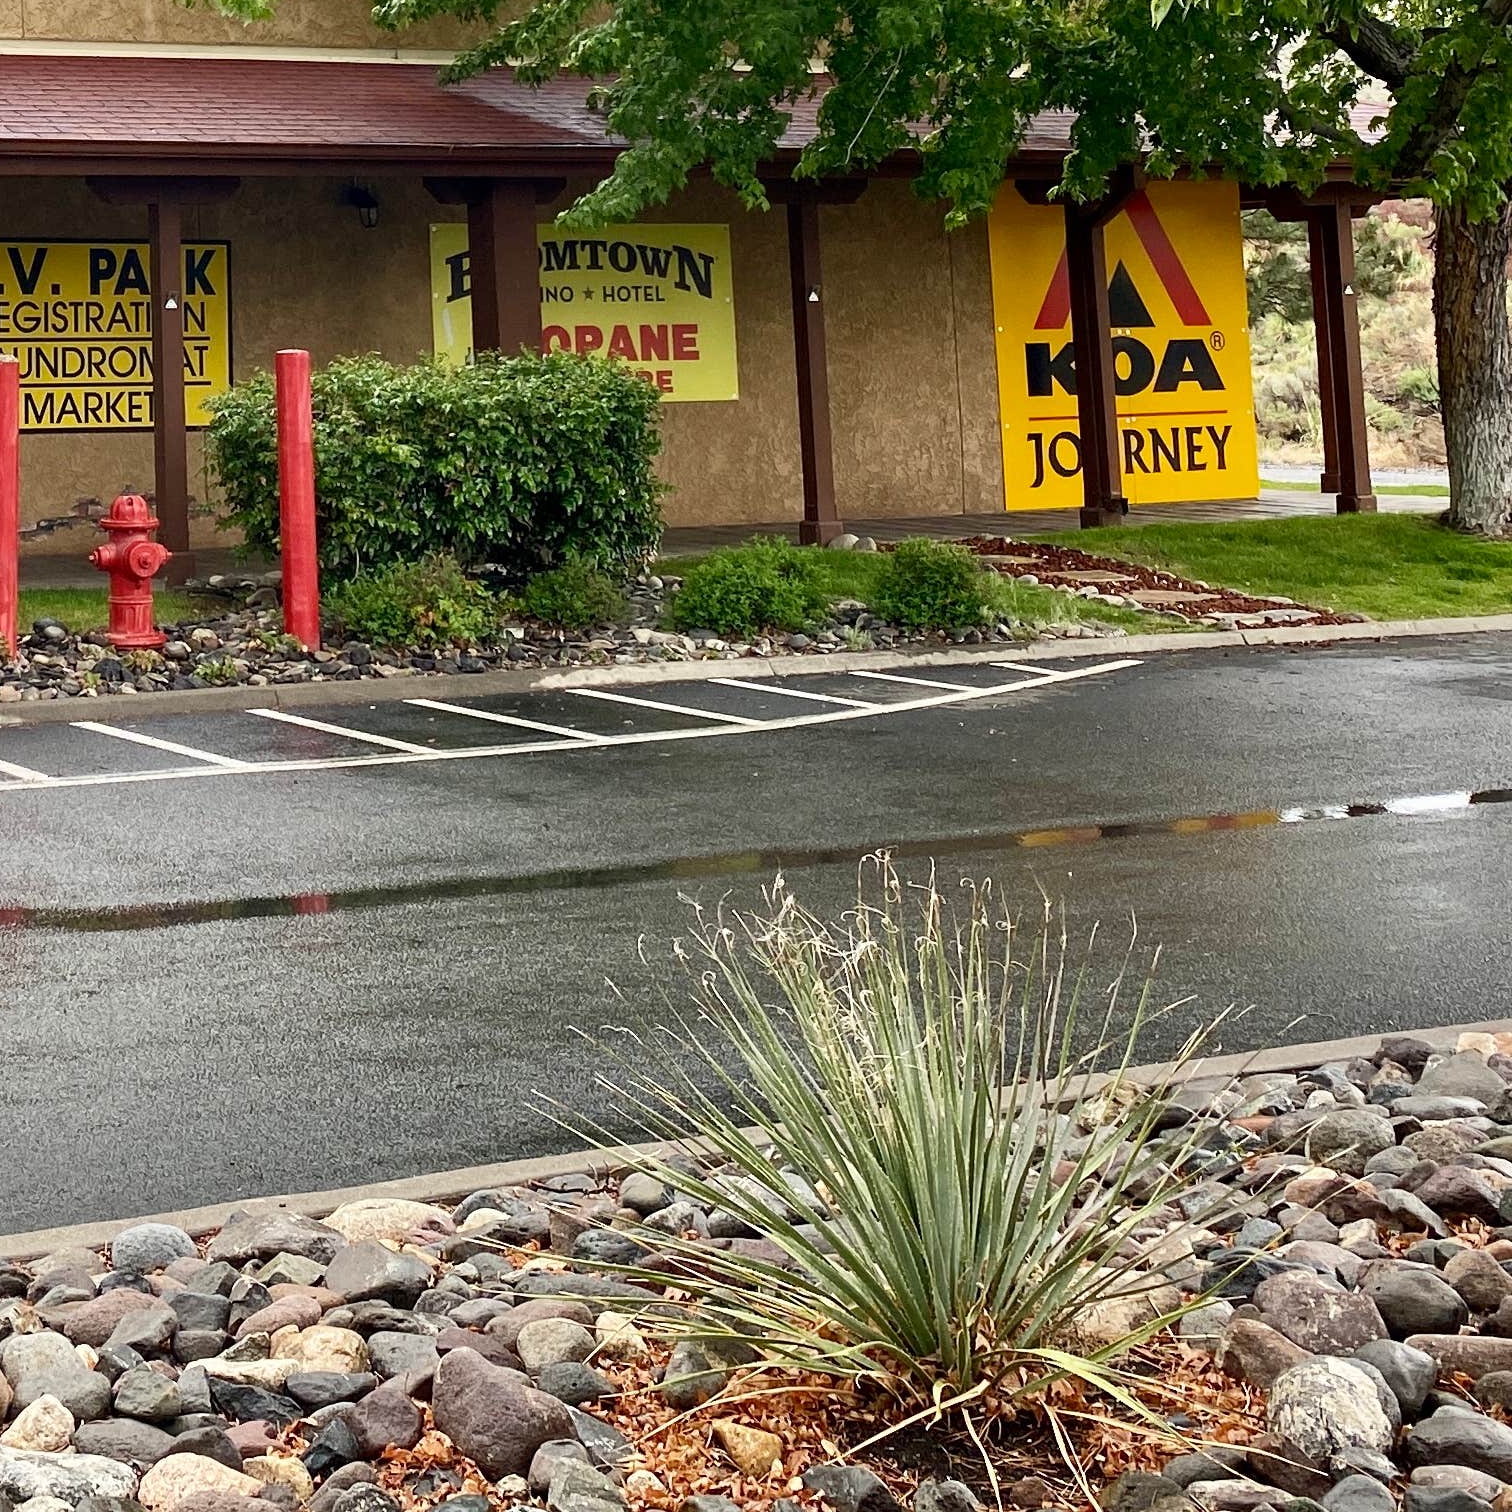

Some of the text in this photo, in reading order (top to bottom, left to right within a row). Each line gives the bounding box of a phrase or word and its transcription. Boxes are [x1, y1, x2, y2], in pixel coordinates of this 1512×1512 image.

[89, 248, 217, 296] PAK
[445, 240, 714, 303] BMTOWN
[602, 285, 666, 303] HOTEL
[541, 323, 700, 362] OPANE
[1024, 336, 1227, 397] KOA
[24, 391, 154, 425] MARKET
[1026, 424, 1233, 489] JORNEY
